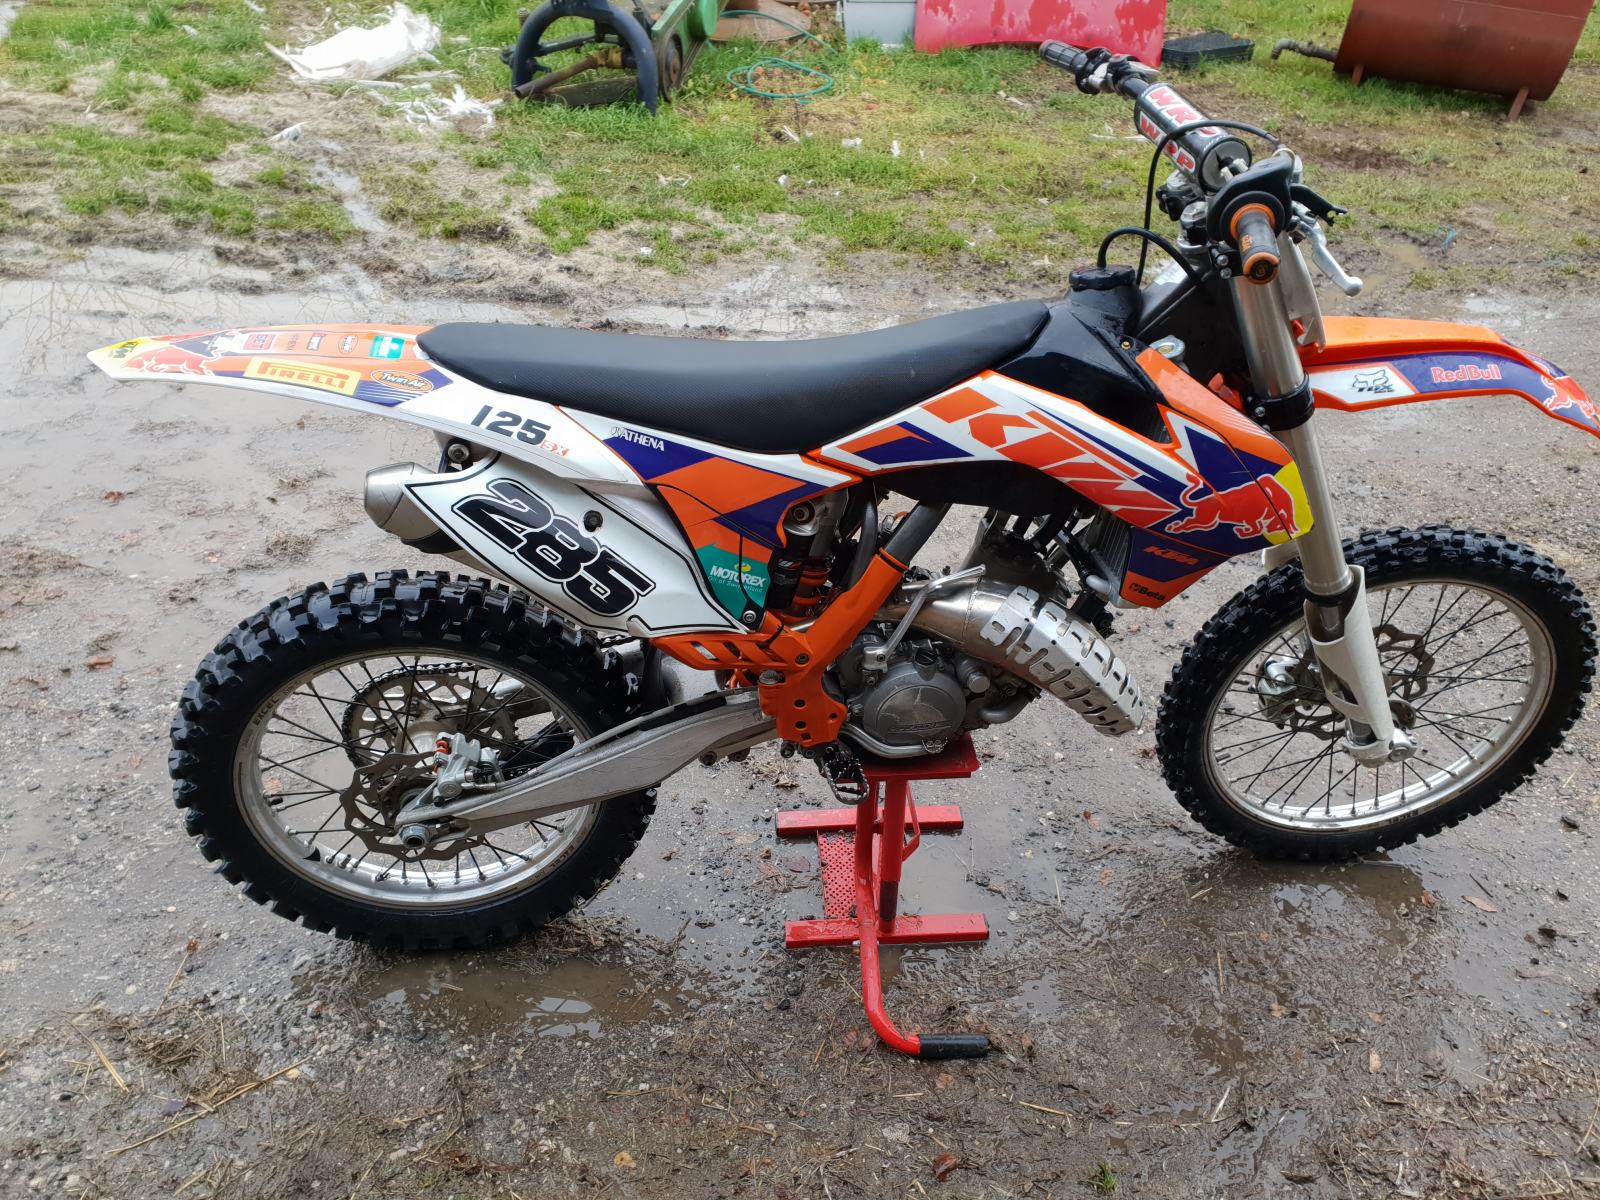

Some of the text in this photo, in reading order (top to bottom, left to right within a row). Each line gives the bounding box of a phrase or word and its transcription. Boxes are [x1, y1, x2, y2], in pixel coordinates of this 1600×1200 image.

[256, 361, 350, 389] PIRELLI
[382, 371, 425, 388] Twin Air
[470, 404, 552, 446] 125
[621, 427, 665, 452] ATHENA
[451, 477, 657, 617] 285
[1143, 545, 1199, 566] KTM
[709, 565, 767, 588] MOTOREX
[1138, 585, 1166, 601] Beta
